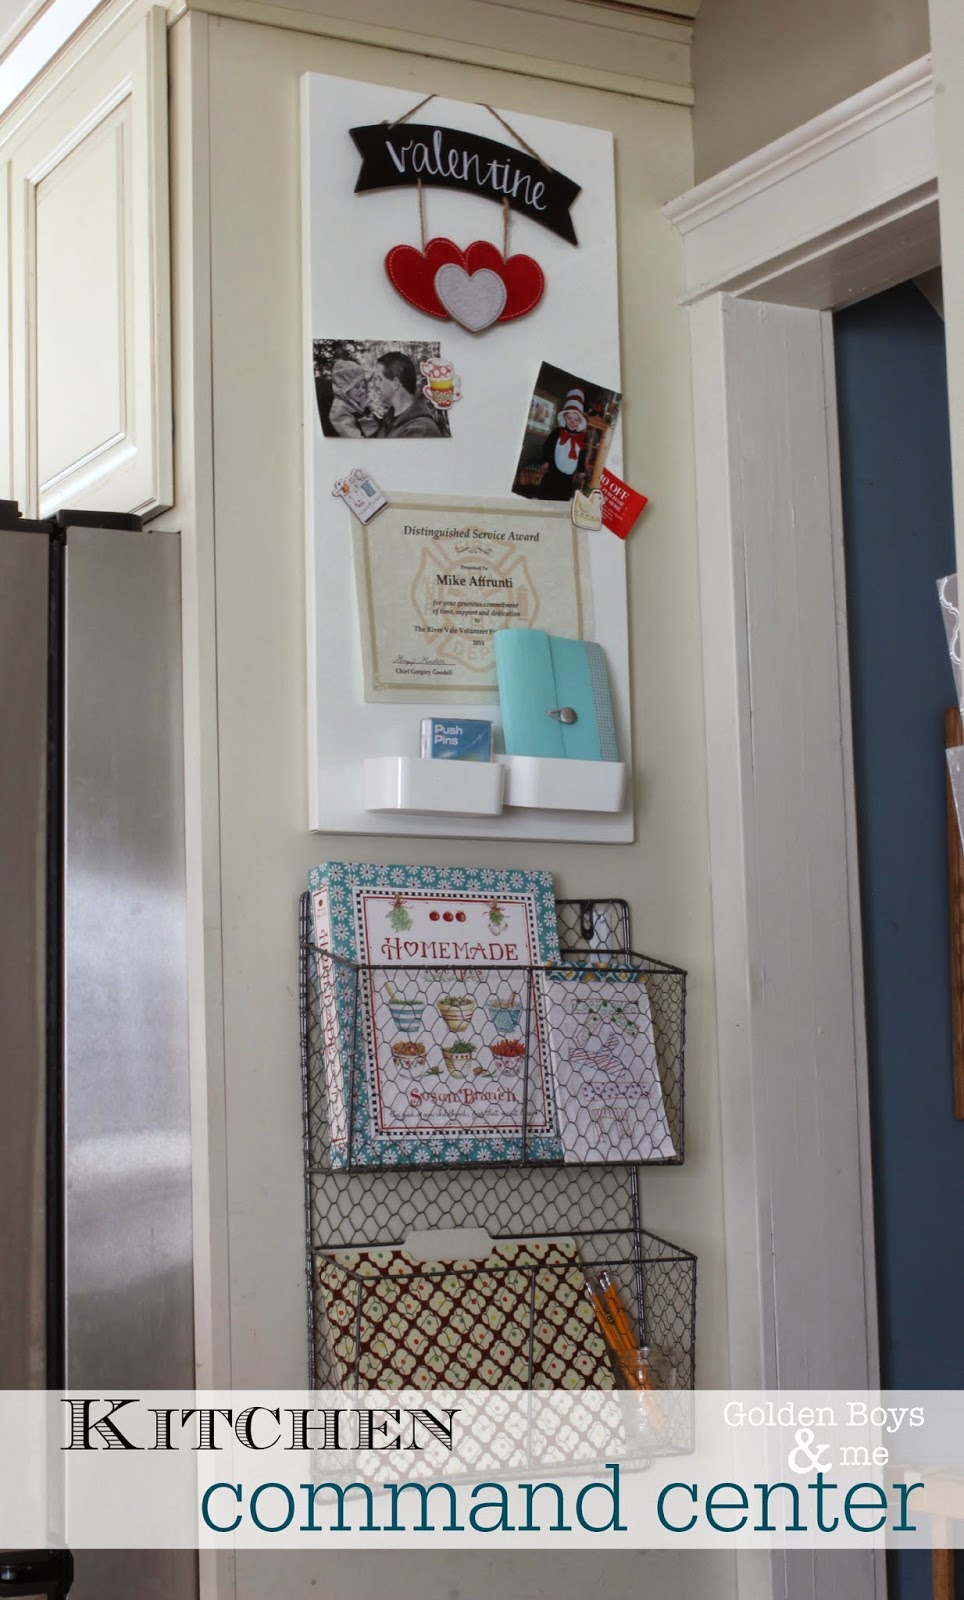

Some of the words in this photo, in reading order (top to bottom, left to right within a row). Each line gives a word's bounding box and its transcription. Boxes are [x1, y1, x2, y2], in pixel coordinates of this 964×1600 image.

[609, 483, 630, 500] OFF
[403, 525, 470, 539] Distinguished
[472, 529, 506, 541] Service
[507, 531, 541, 542] Award
[436, 574, 466, 586] Mike
[469, 576, 513, 588] Affrunti
[432, 608, 439, 616] of
[460, 627, 488, 635] Volunteer
[434, 724, 463, 735] Push
[434, 735, 458, 745] Pins
